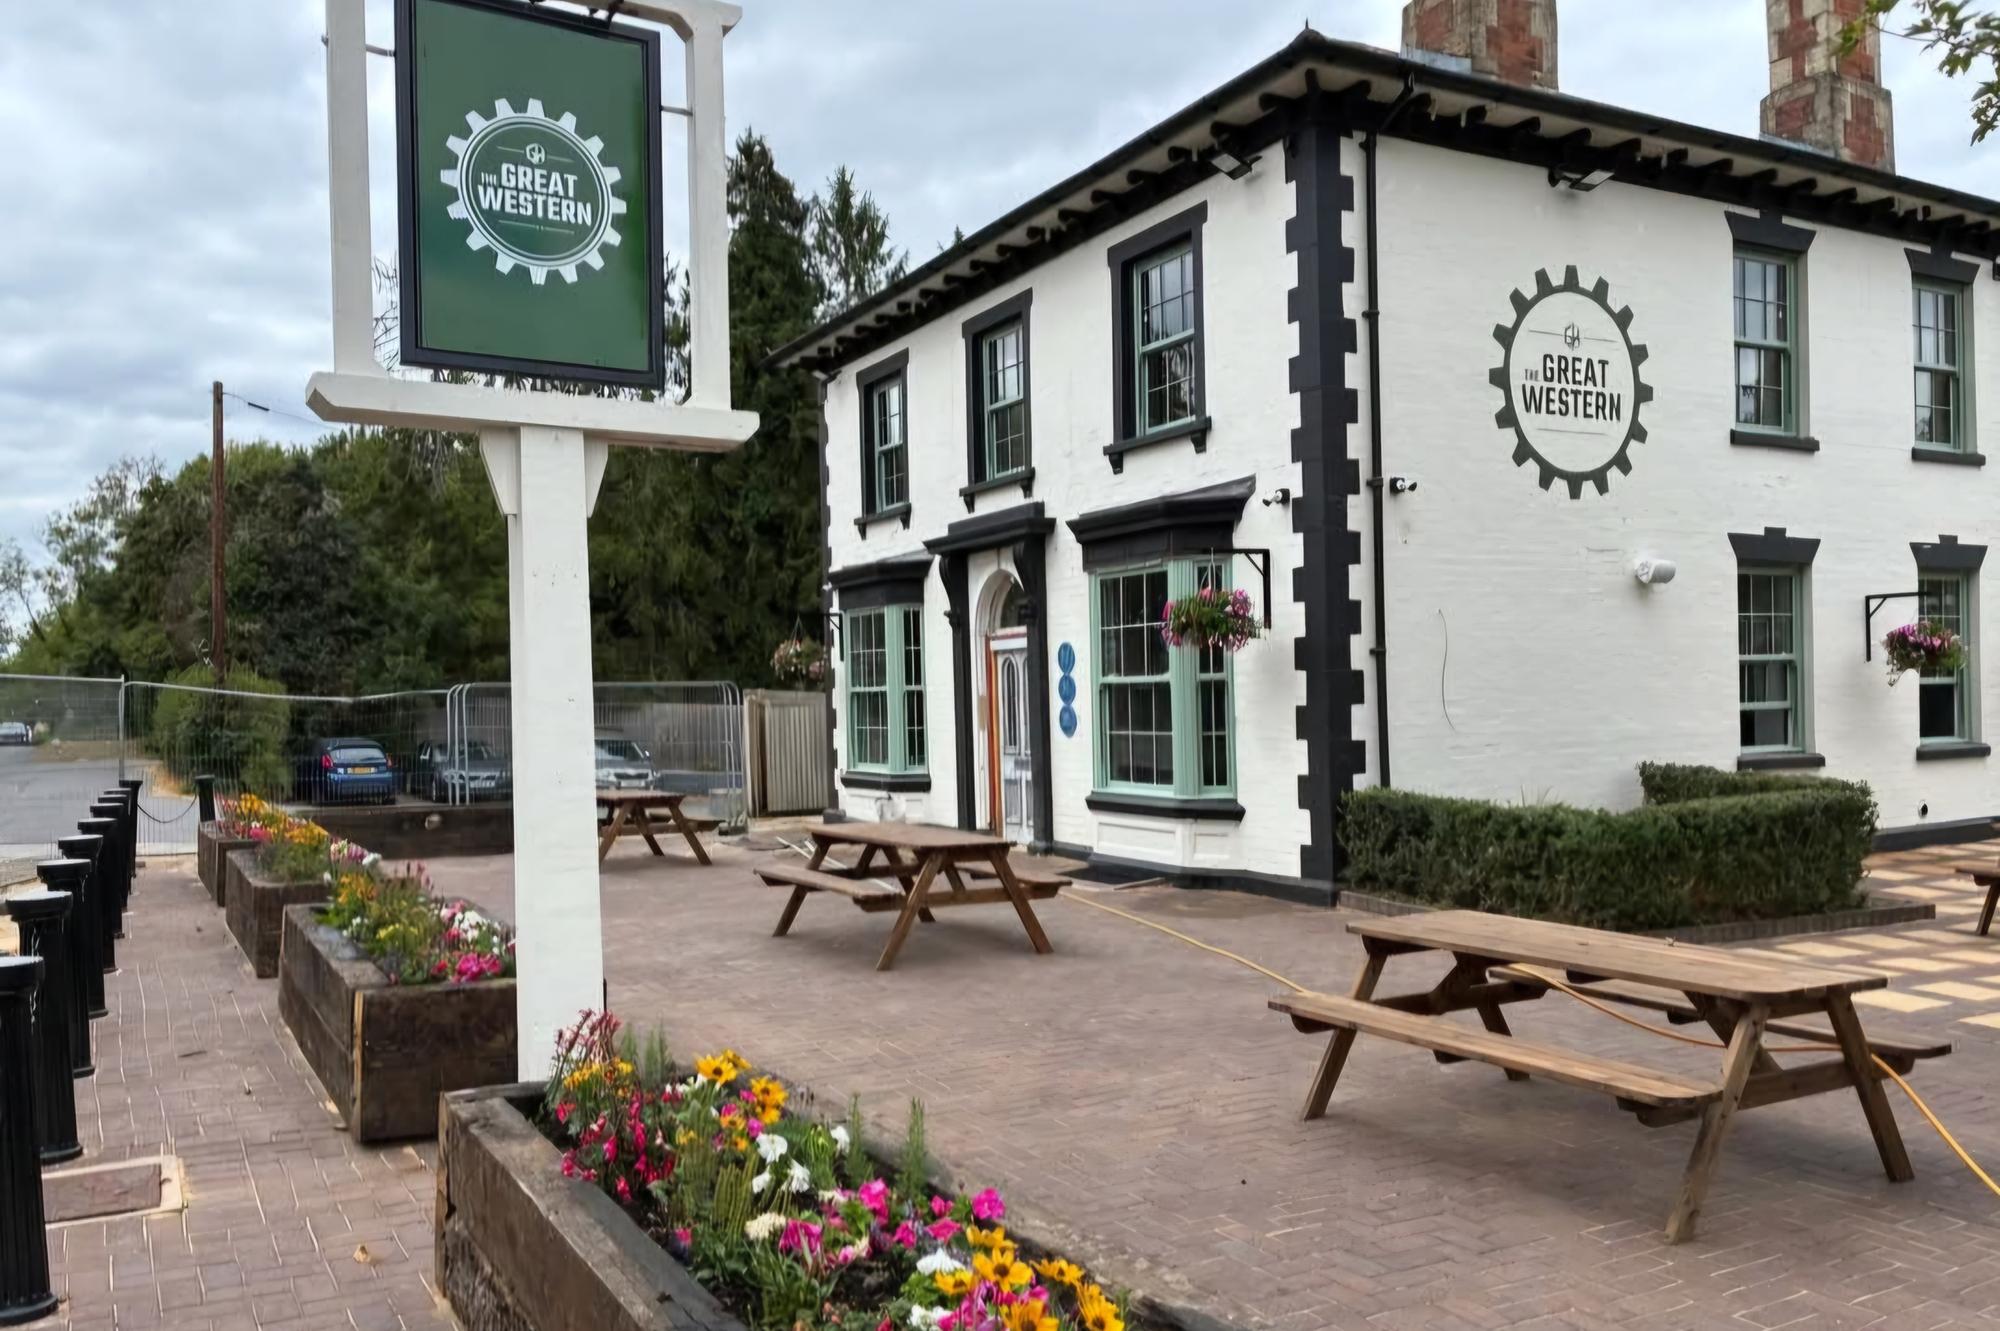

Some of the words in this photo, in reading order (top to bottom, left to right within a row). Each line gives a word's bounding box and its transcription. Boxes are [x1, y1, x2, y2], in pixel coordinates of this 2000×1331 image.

[501, 162, 578, 198] GREAT
[478, 185, 592, 226] WESTERN
[1525, 368, 1540, 382] THE
[1543, 354, 1609, 388] GREAT
[1522, 384, 1621, 422] WESTERN
